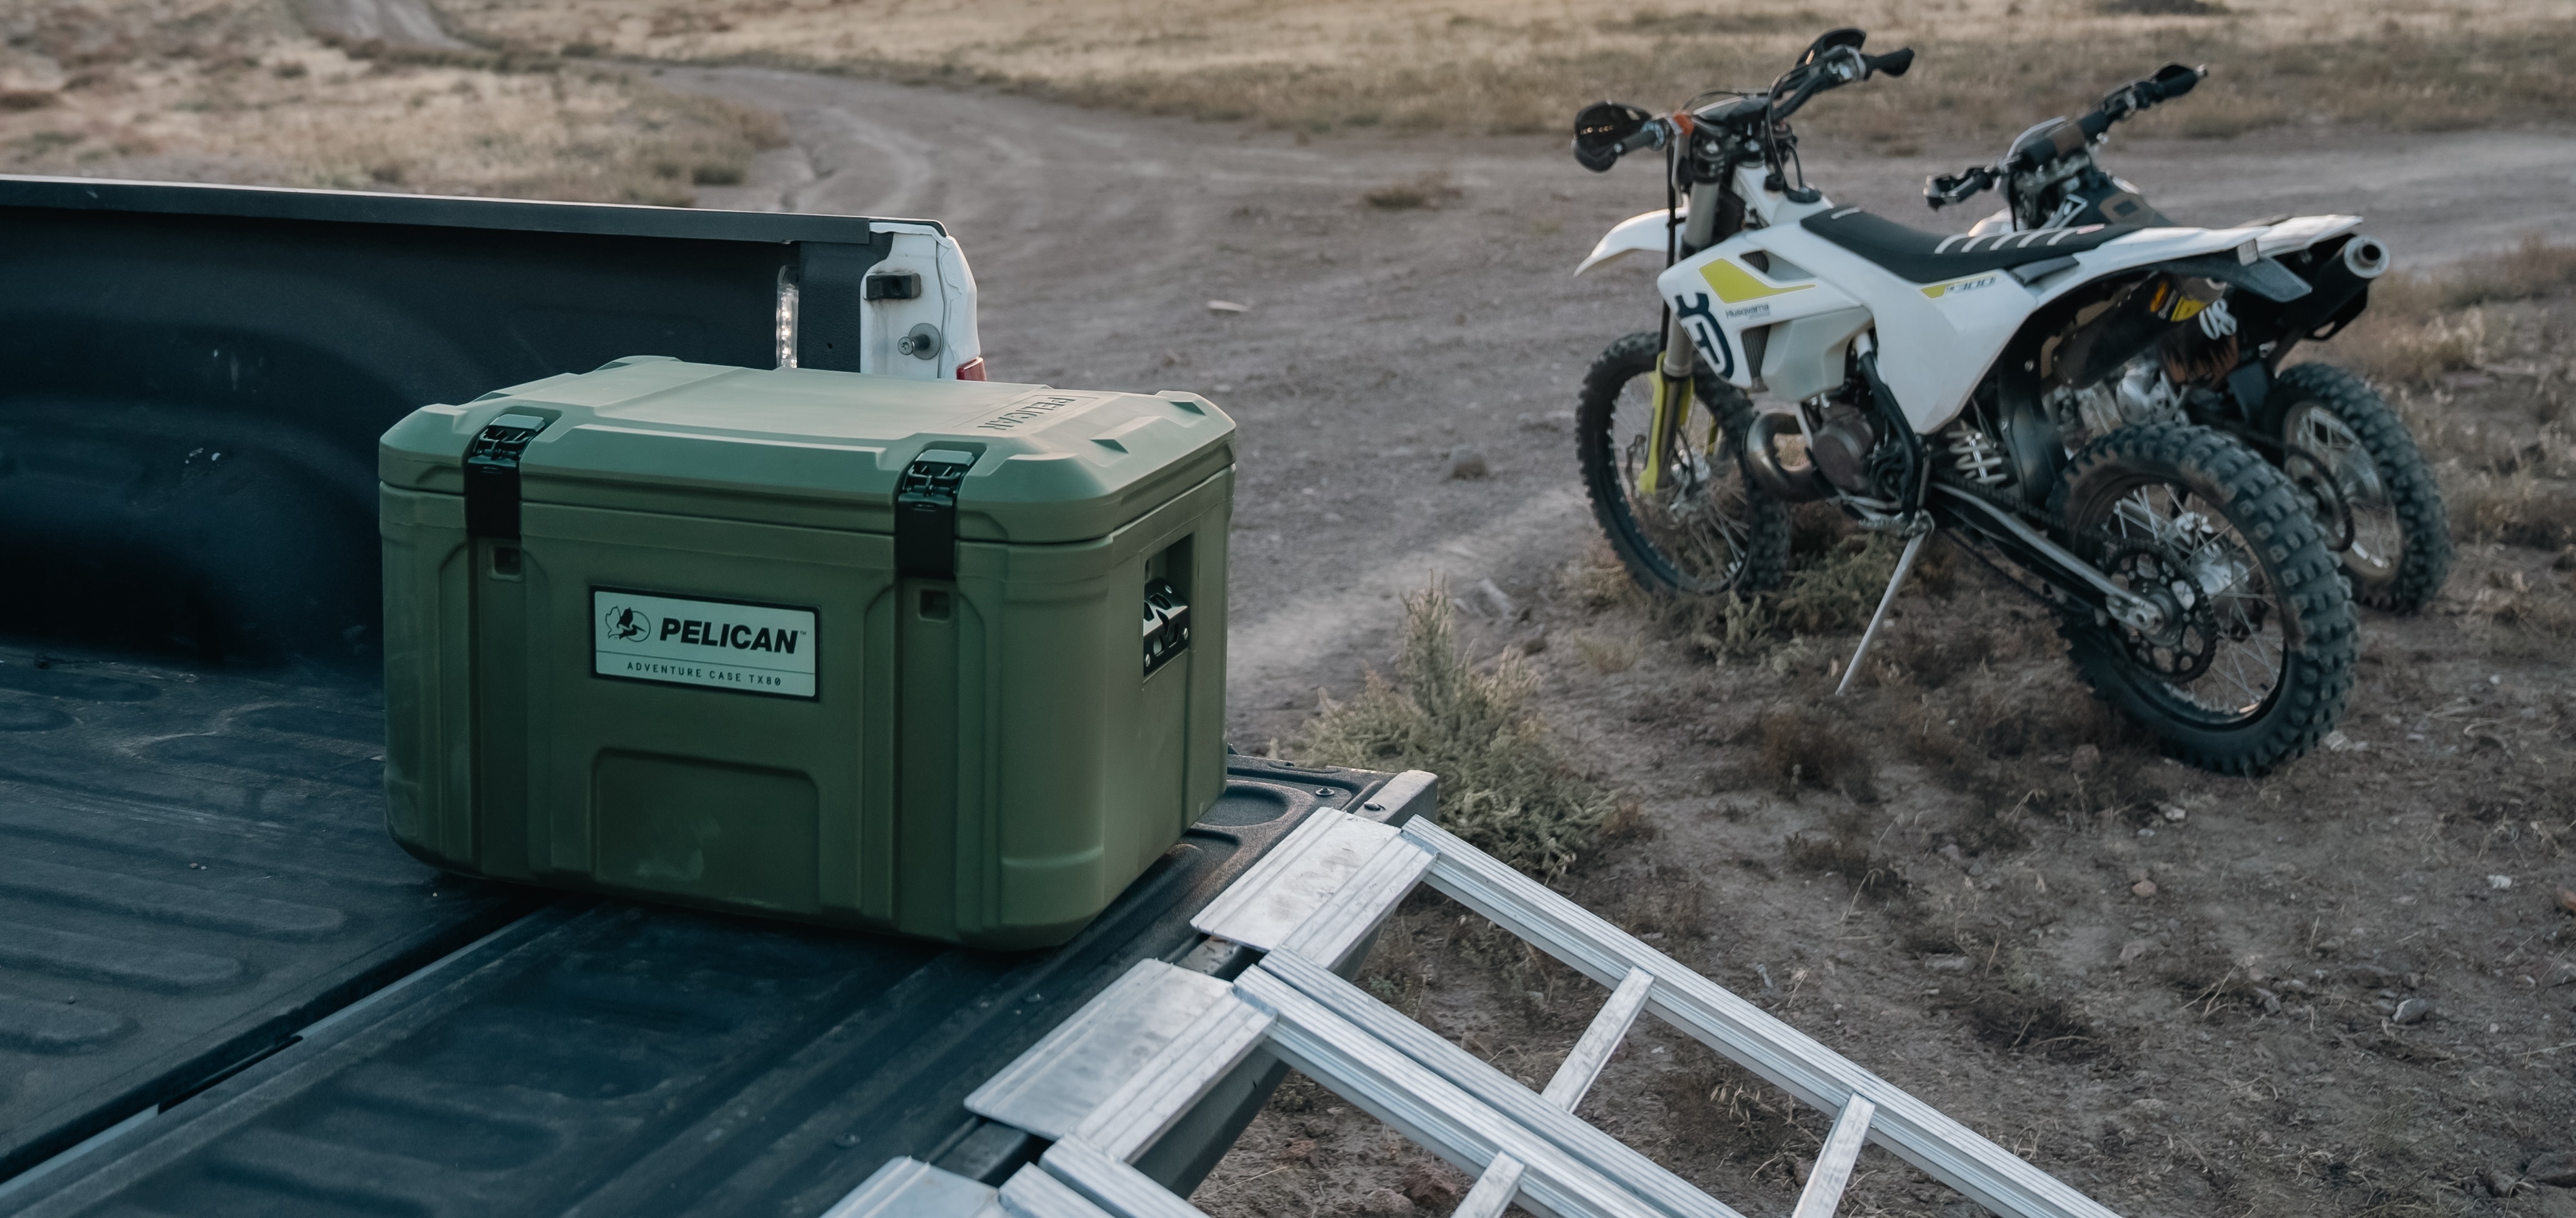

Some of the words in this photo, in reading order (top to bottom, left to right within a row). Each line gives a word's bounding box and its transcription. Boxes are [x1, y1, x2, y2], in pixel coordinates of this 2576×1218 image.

[977, 397, 1077, 431] PELICAN
[660, 617, 798, 654] PELICAN
[627, 661, 702, 678] ADVENTURE
[710, 670, 741, 682] CASE
[748, 674, 781, 686] TX80
